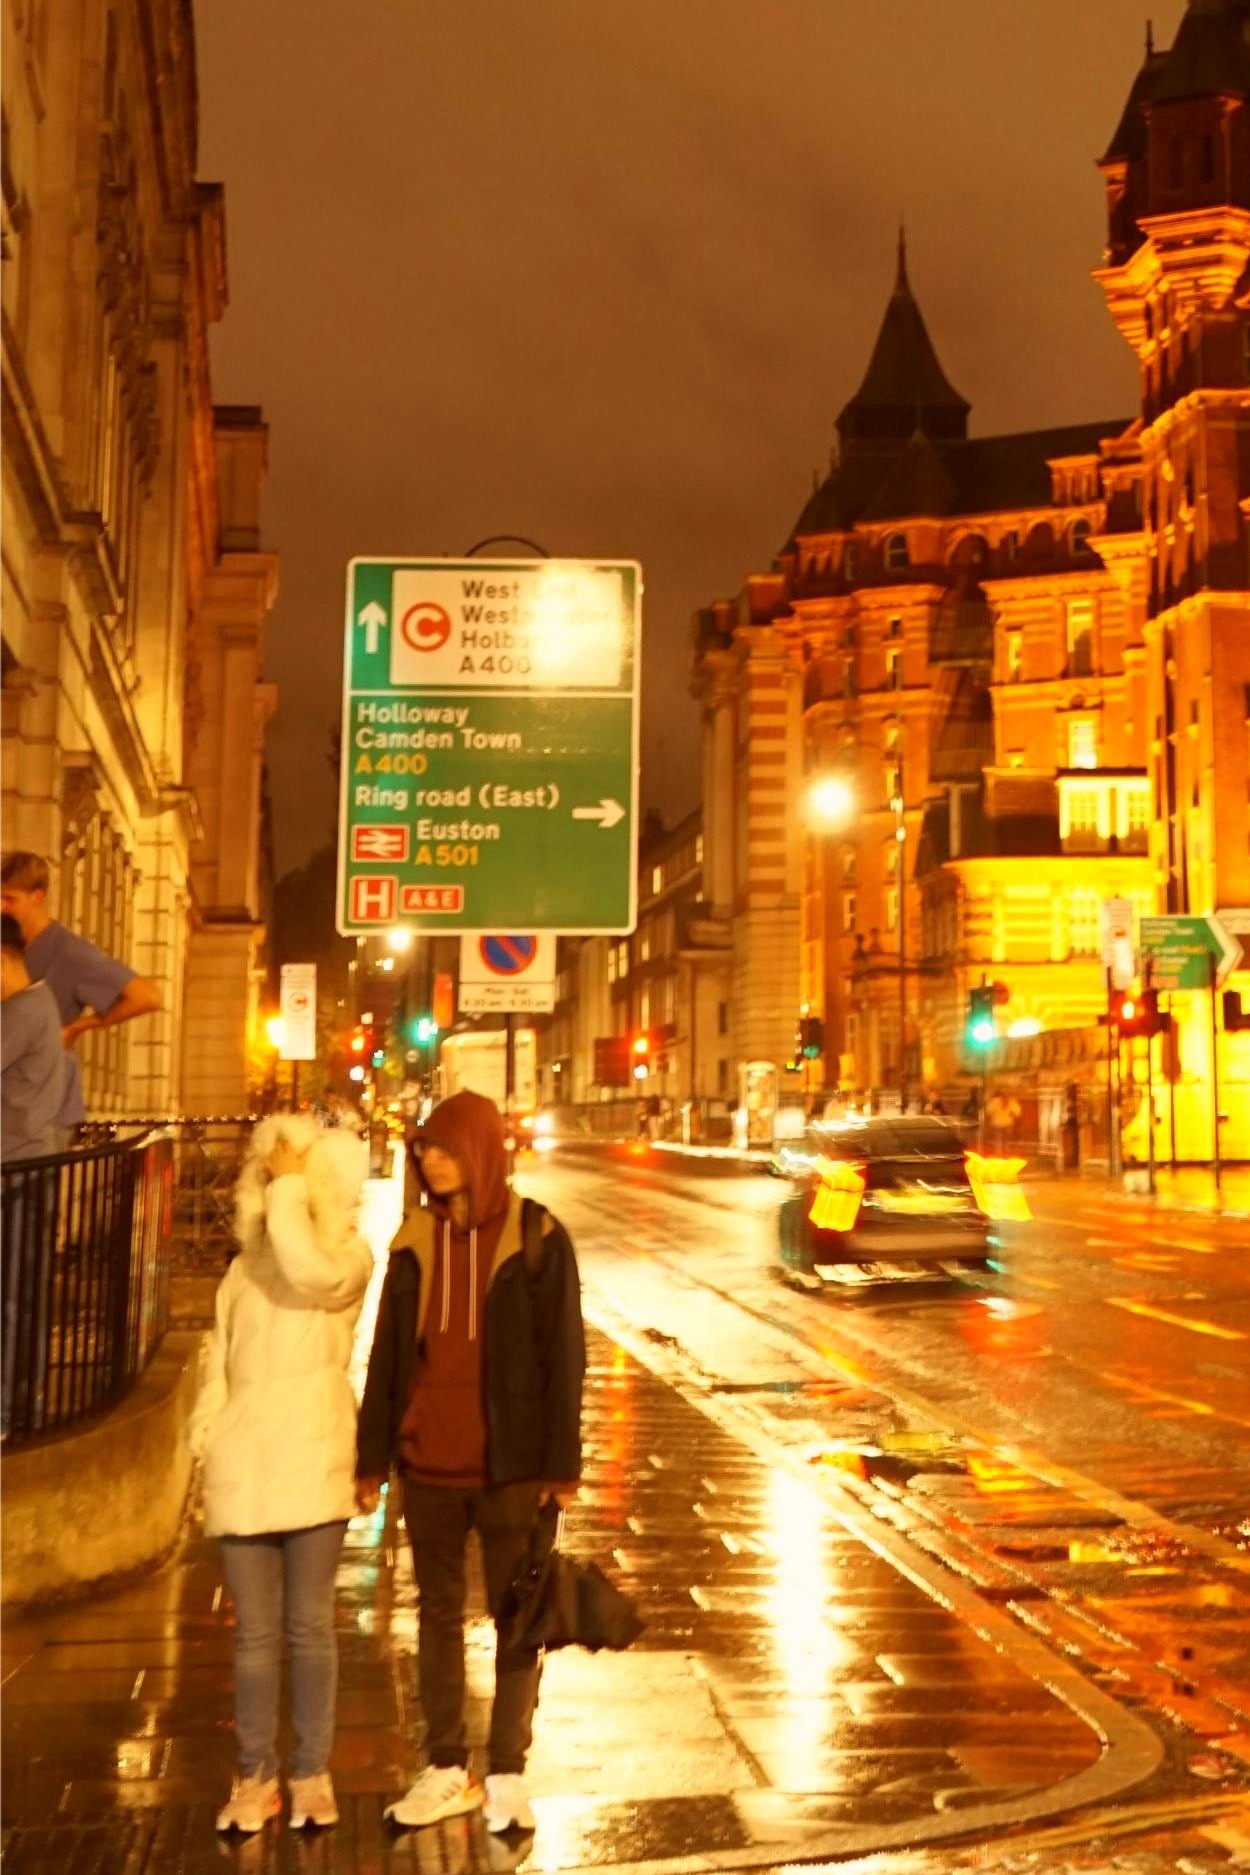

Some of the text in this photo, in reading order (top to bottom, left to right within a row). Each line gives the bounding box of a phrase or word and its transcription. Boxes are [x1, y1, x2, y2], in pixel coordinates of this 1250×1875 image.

[461, 579, 519, 599] West
[459, 654, 532, 674] A400
[357, 702, 470, 728] Holloway
[355, 727, 523, 750] Camden Town
[355, 753, 429, 774] A400
[354, 781, 560, 810] Ring road (East)
[416, 819, 501, 841] Euston
[415, 844, 480, 867] A501
[357, 880, 391, 918] H
[407, 890, 456, 909] A&E
